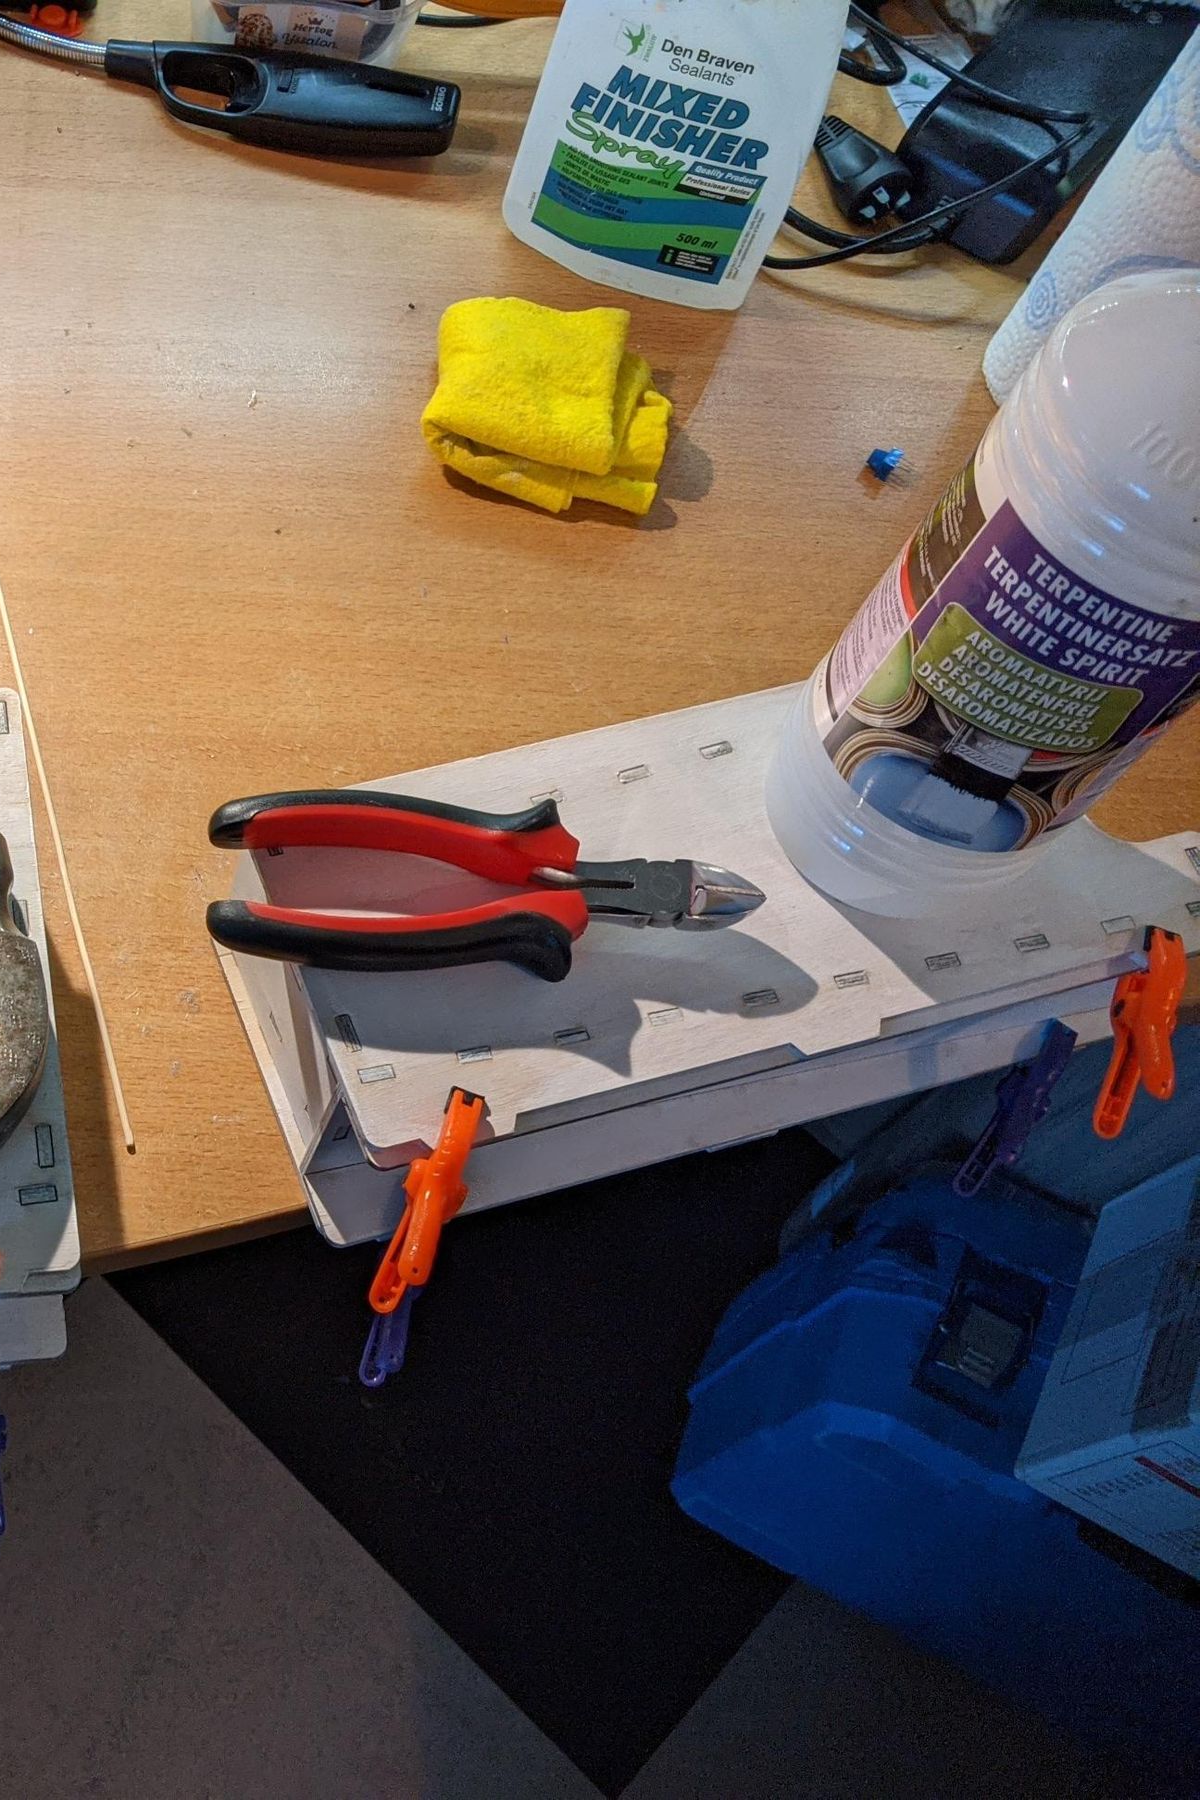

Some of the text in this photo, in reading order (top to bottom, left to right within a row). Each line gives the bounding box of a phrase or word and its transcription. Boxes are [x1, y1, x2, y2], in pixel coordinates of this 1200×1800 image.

[293, 23, 333, 38] Hertog
[661, 39, 755, 75] Den Braven
[607, 64, 750, 130] MIXED
[669, 57, 735, 87] Sealants
[566, 110, 685, 180] Spray
[570, 82, 769, 171] FINISHER
[621, 170, 648, 182] SEALANT
[684, 175, 750, 196] Professional Series
[694, 164, 759, 185] Quality Product
[675, 232, 718, 250] 500 ml
[982, 545, 1194, 669] TERPENTINERSATZ
[1027, 553, 1177, 644] TERPENTINE
[965, 630, 1111, 703] AROMAATVRIJ
[984, 591, 1149, 686] WHITE SPIRIT
[917, 662, 1097, 750] DESAROMATIZADOS
[952, 645, 1098, 718] AROMATENFREI
